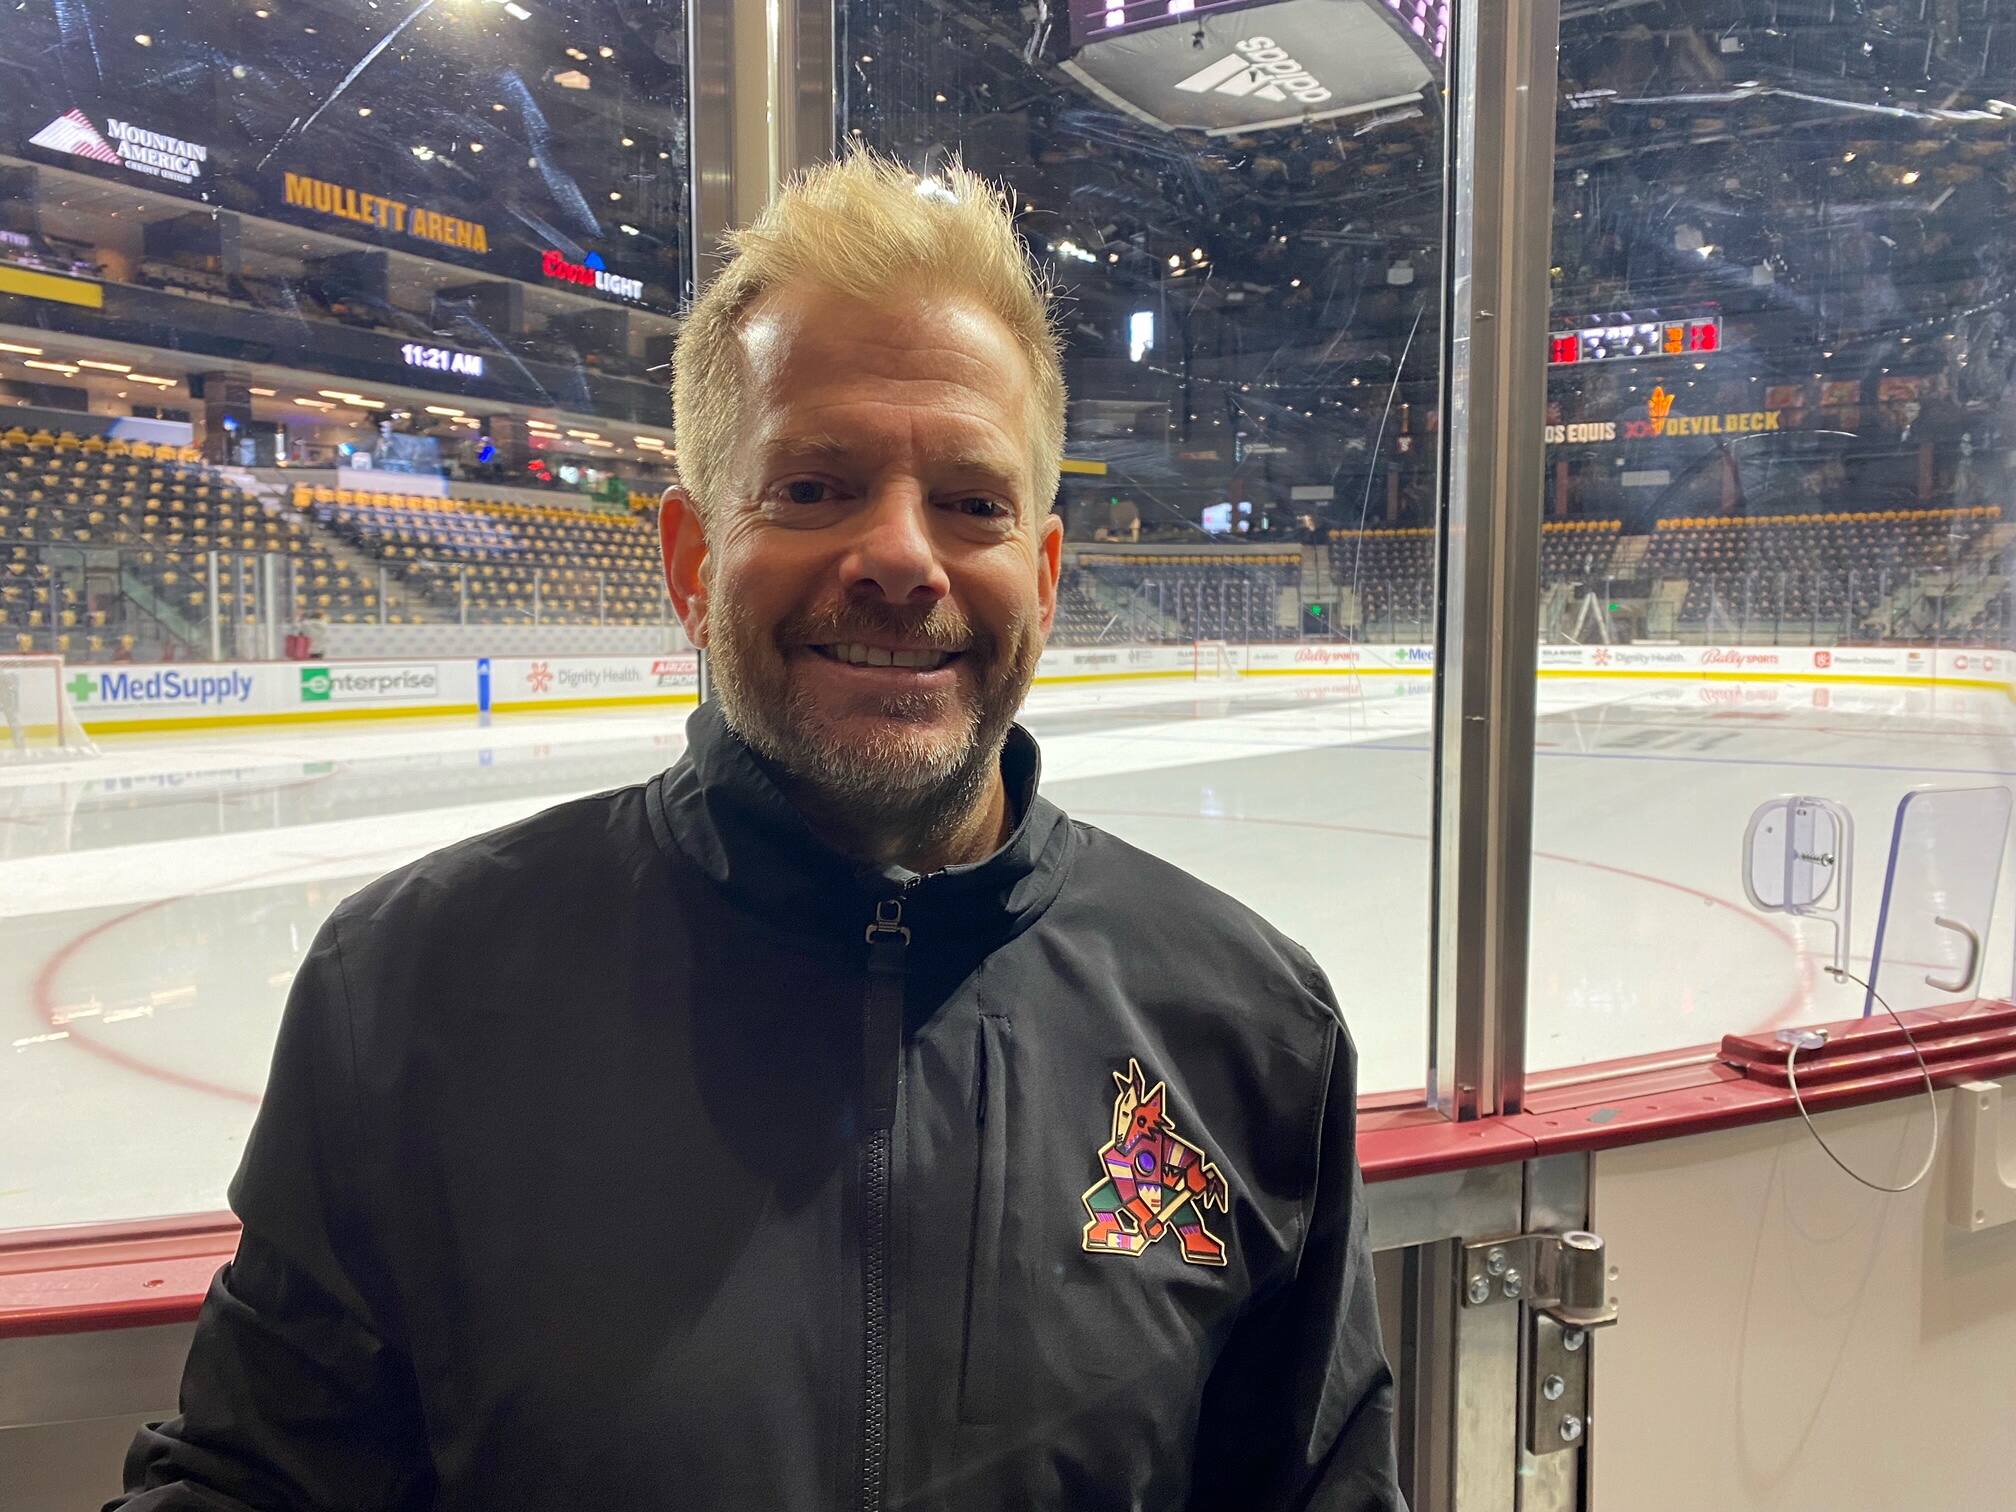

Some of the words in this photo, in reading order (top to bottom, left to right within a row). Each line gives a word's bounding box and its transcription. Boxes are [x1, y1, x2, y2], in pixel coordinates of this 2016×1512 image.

[1235, 36, 1333, 102] adidas
[106, 118, 208, 162] MOUNTAIN
[116, 141, 201, 177] AMERICA
[284, 171, 408, 233] MULLETT
[410, 207, 489, 254] ARENA
[595, 270, 644, 300] LIGHT
[401, 343, 450, 371] 11:21
[450, 352, 483, 377] AM
[1544, 424, 1566, 443] OS
[1566, 421, 1616, 443] EQUIS
[1664, 415, 1722, 437] DEVIL
[1725, 410, 1781, 432] BECK
[1296, 647, 1330, 664] Bally
[1614, 651, 1650, 665] Dignity
[1651, 650, 1685, 663] Health
[1700, 647, 1745, 668] Bally
[1745, 654, 1779, 665] SPORTS
[100, 671, 252, 705] MedSupply
[308, 670, 436, 694] enterprise
[558, 666, 600, 687] Dignity
[602, 667, 640, 682] Health
